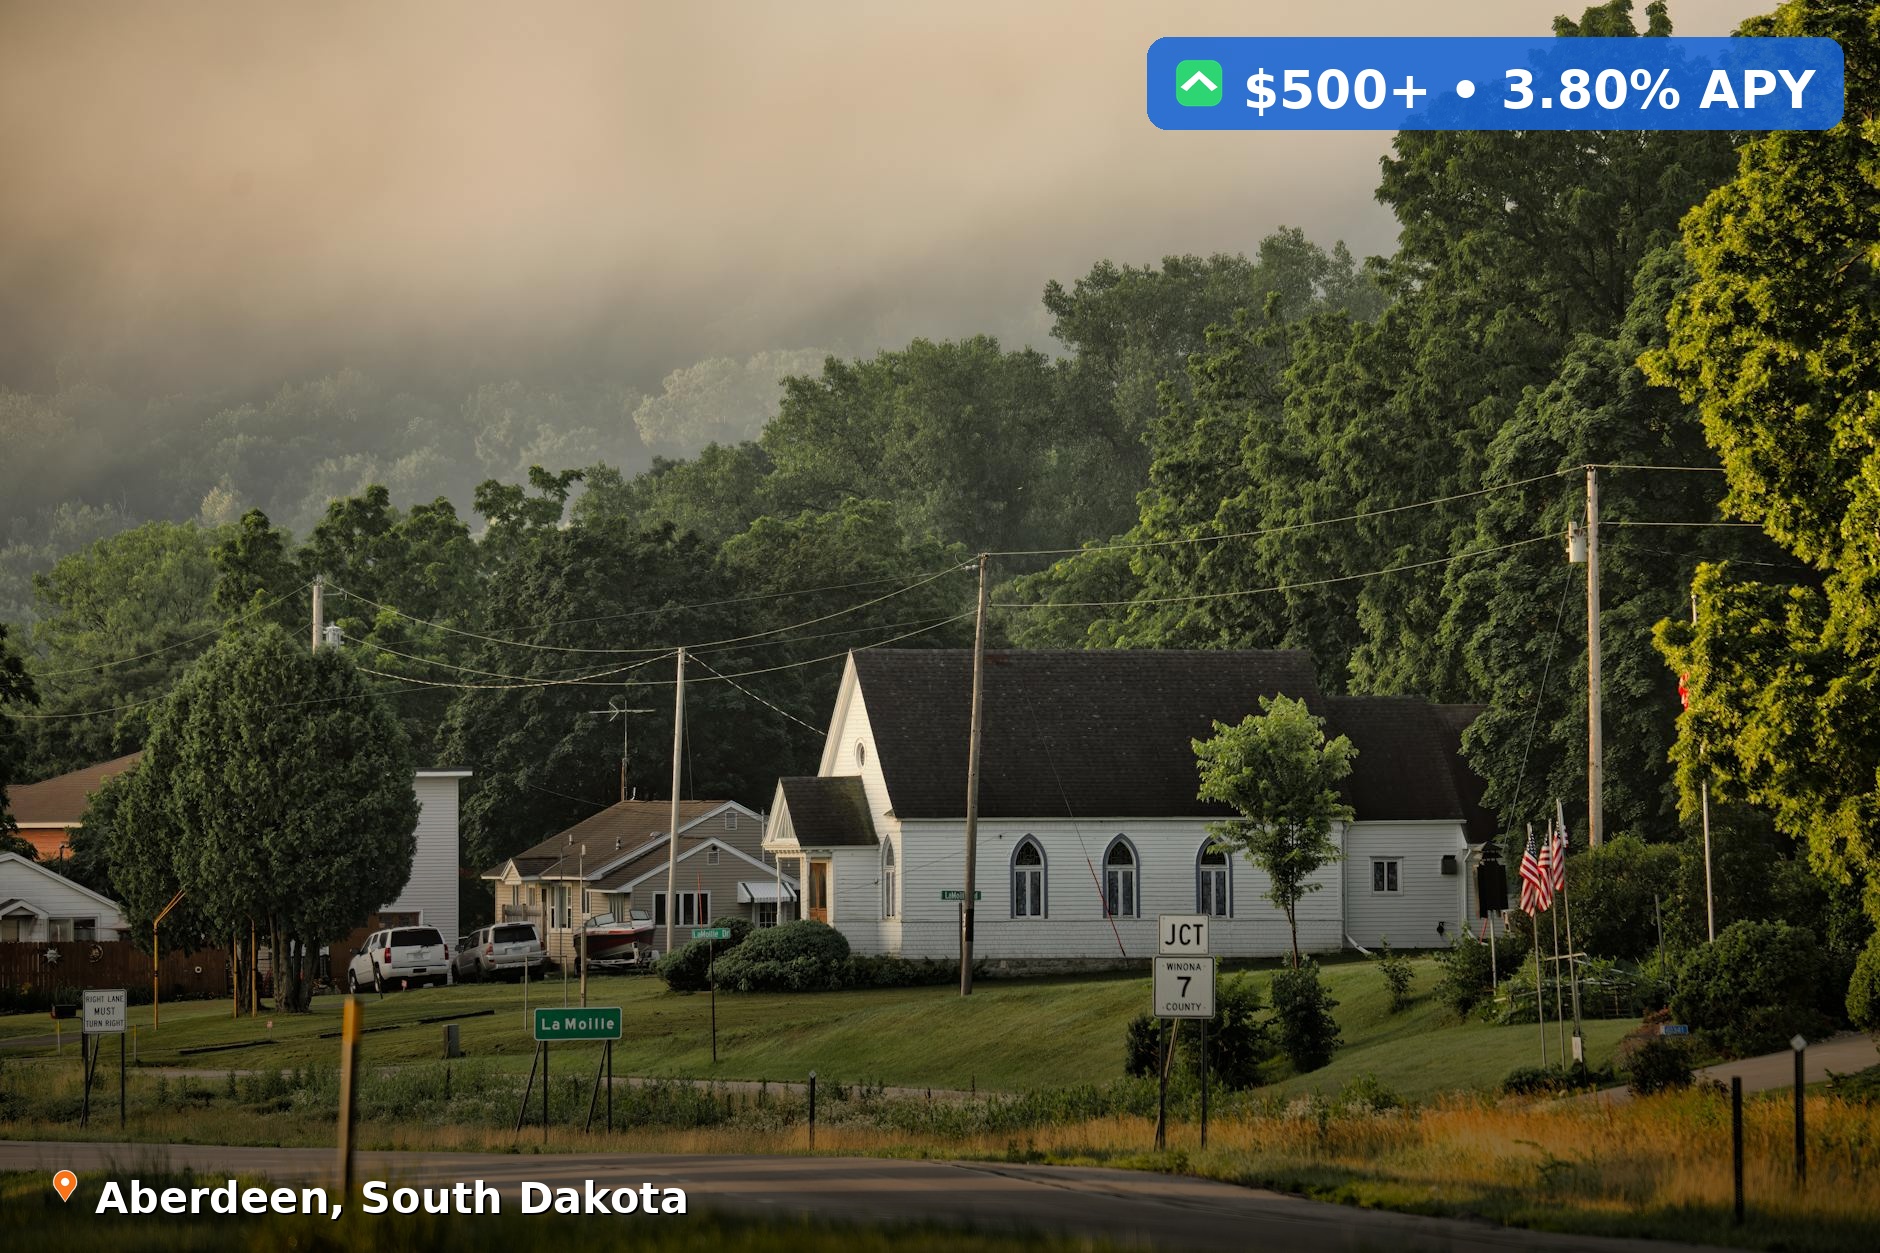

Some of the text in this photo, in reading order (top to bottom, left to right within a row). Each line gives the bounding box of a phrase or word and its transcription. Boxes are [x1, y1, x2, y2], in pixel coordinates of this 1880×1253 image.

[721, 929, 730, 938] Dr
[1165, 923, 1204, 946] JCT
[1166, 963, 1202, 971] WINONA
[1177, 976, 1192, 998] 7
[85, 995, 125, 1003] RIGHT LANE
[94, 1006, 115, 1015] MUST
[1165, 1002, 1202, 1011] COUNTY
[86, 1019, 124, 1028] TURN RIGHT
[564, 1017, 615, 1030] Moille
